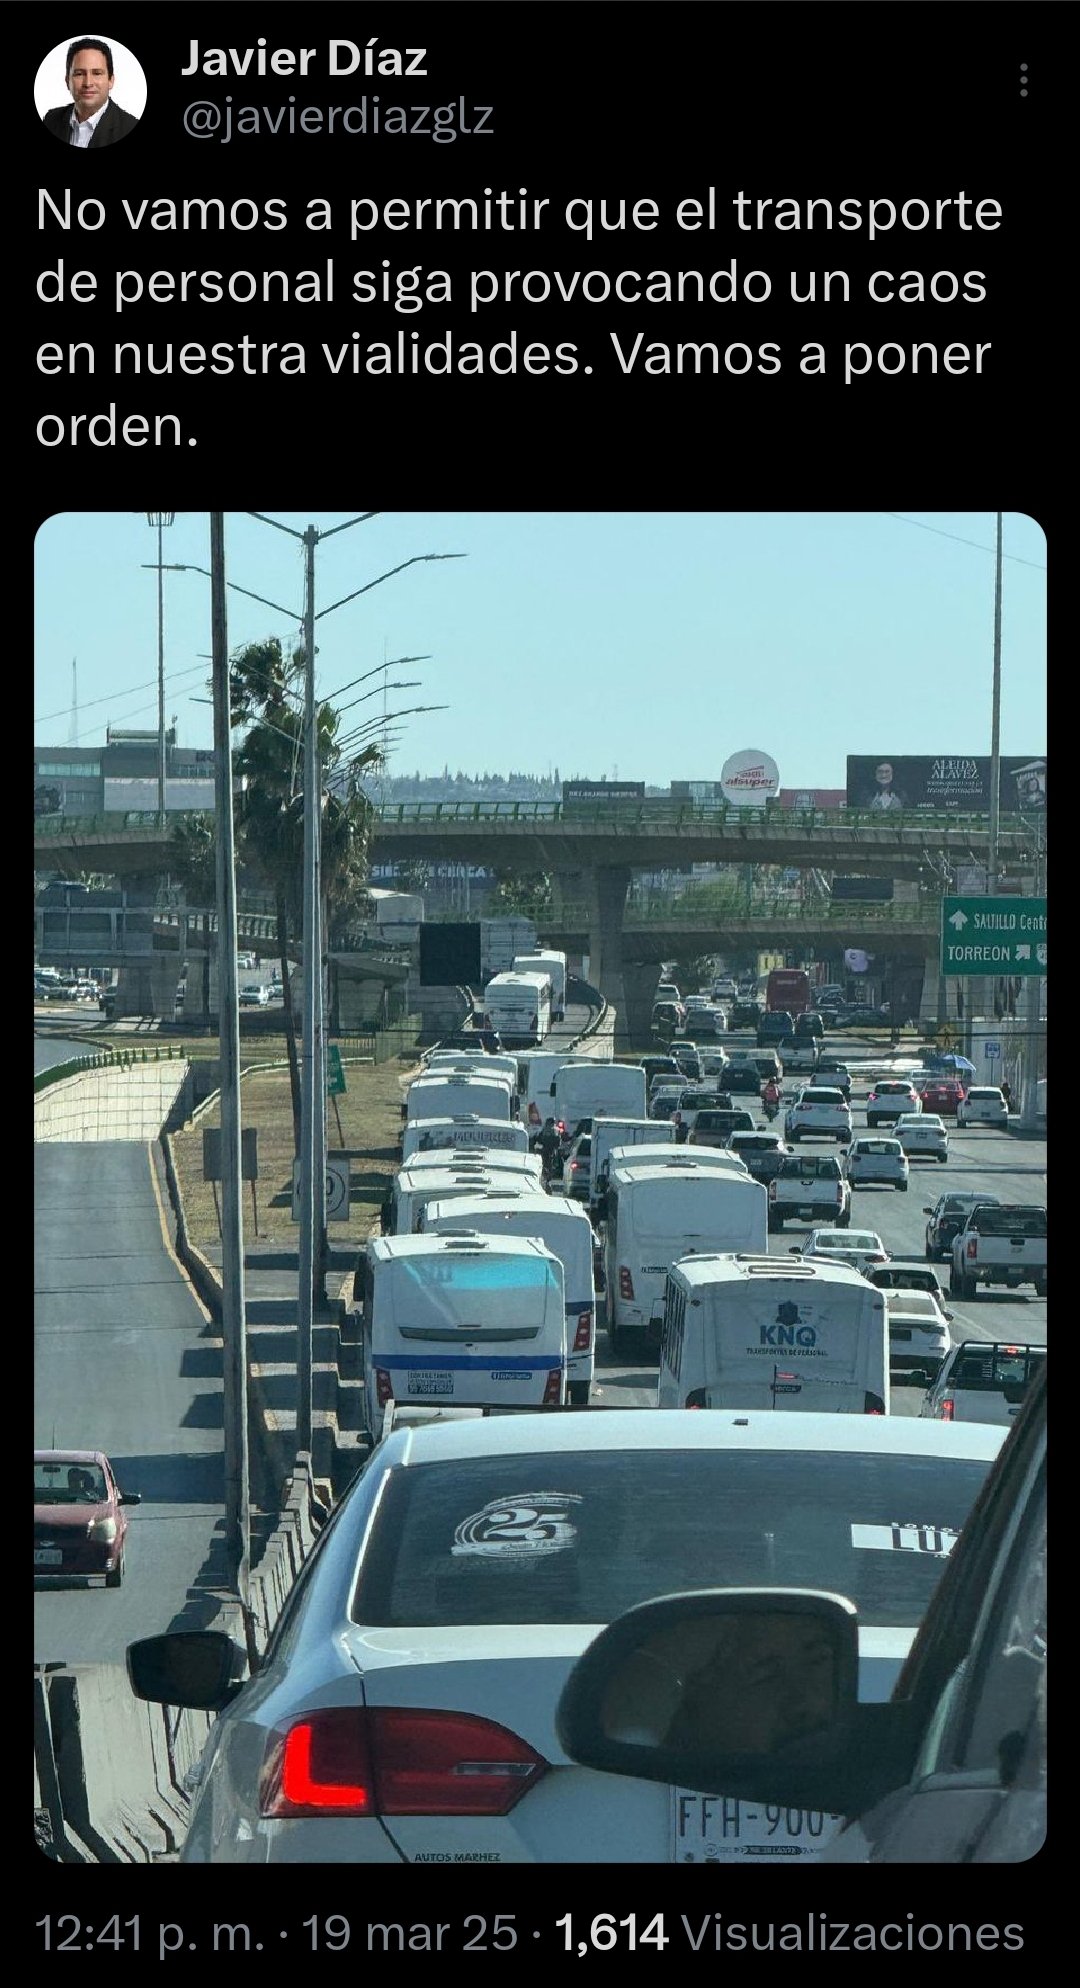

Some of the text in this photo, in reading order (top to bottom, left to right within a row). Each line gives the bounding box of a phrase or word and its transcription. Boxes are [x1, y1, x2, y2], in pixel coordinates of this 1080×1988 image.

[974, 913, 1016, 930] SALTILLO
[948, 946, 1010, 961] TORREON
[760, 1325, 816, 1347] KNQ
[483, 1508, 577, 1541] 25
[892, 1529, 959, 1553] LU
[414, 1853, 452, 1862] AUTOS
